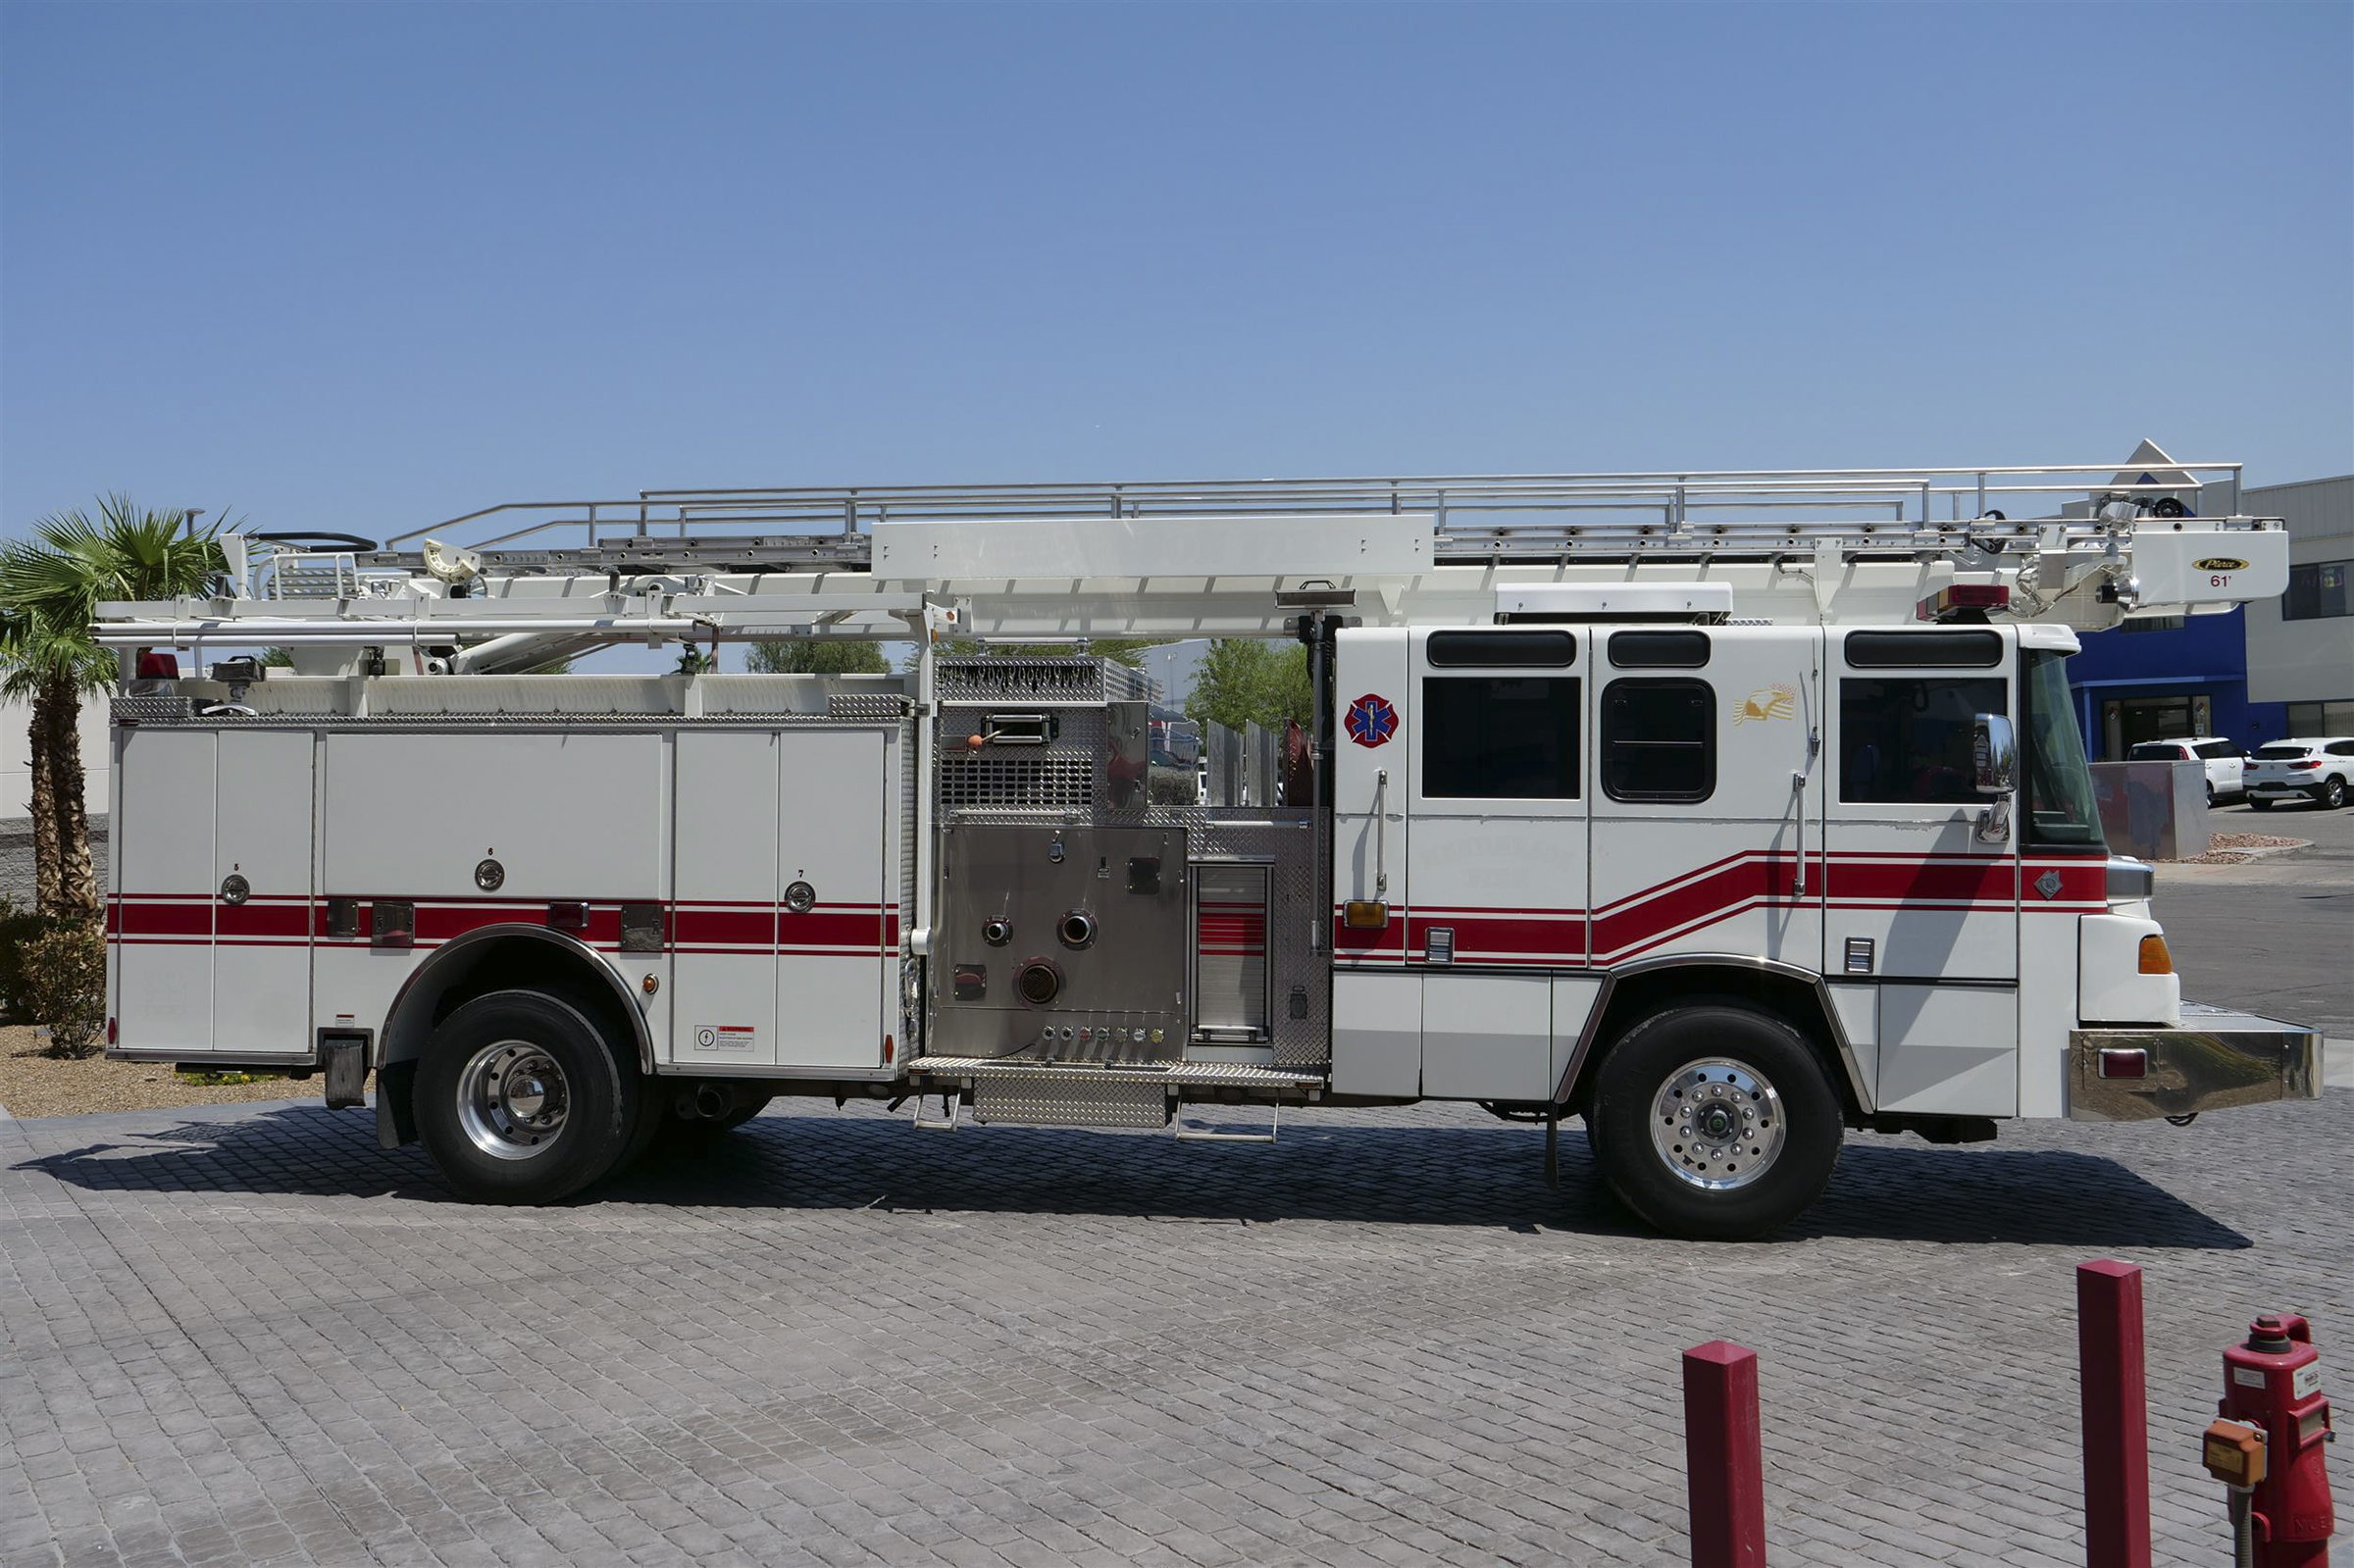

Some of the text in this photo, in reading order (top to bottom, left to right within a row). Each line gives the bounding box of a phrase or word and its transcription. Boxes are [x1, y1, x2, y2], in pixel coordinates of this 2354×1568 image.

[2205, 559, 2235, 569] Pierce
[487, 847, 493, 856] 6
[798, 869, 804, 878] 7
